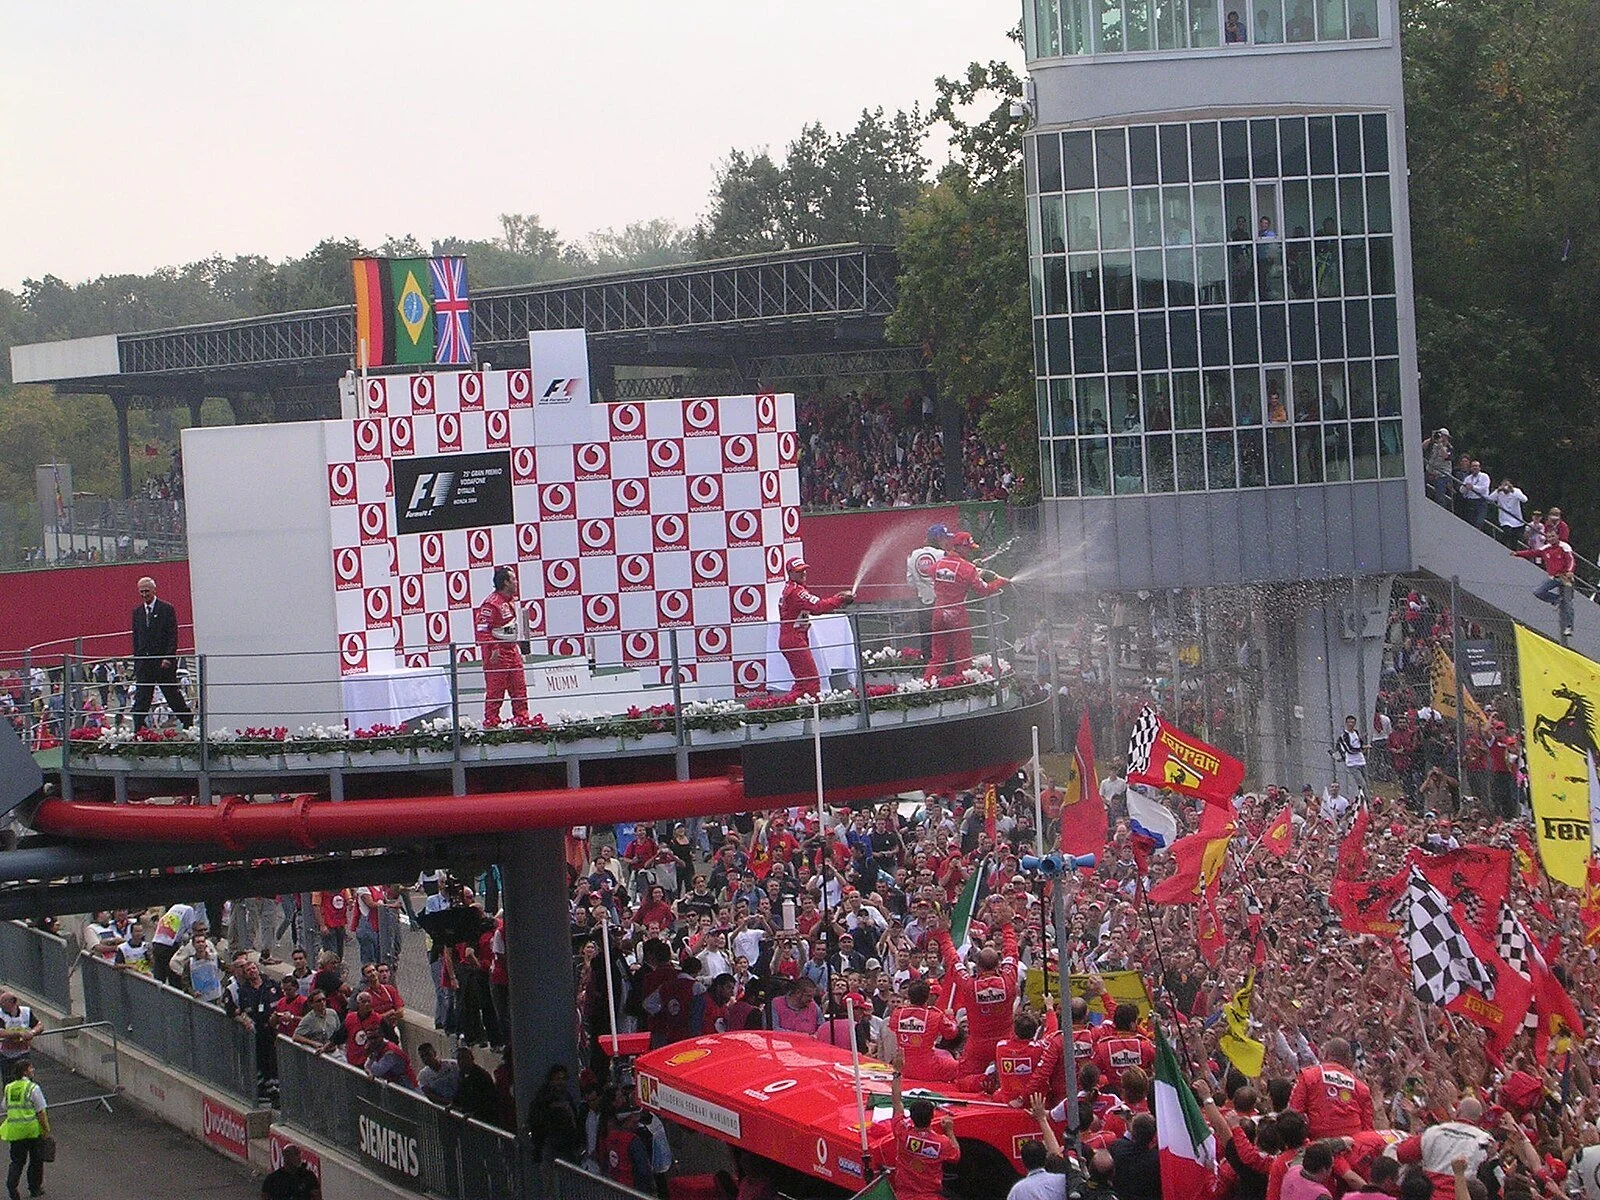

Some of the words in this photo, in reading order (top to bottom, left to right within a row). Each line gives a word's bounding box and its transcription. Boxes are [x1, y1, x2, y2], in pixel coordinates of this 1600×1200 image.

[408, 472, 455, 509] F1
[546, 675, 578, 692] MUMM
[1161, 731, 1220, 776] Ferrari
[977, 990, 1004, 1002] Marlboro
[900, 1020, 924, 1031] Marlboro
[1074, 1044, 1092, 1056] rlboro
[1112, 1052, 1140, 1065] Marlboro
[1324, 1074, 1354, 1088] Marlboro
[359, 1114, 419, 1177] SIEMENS
